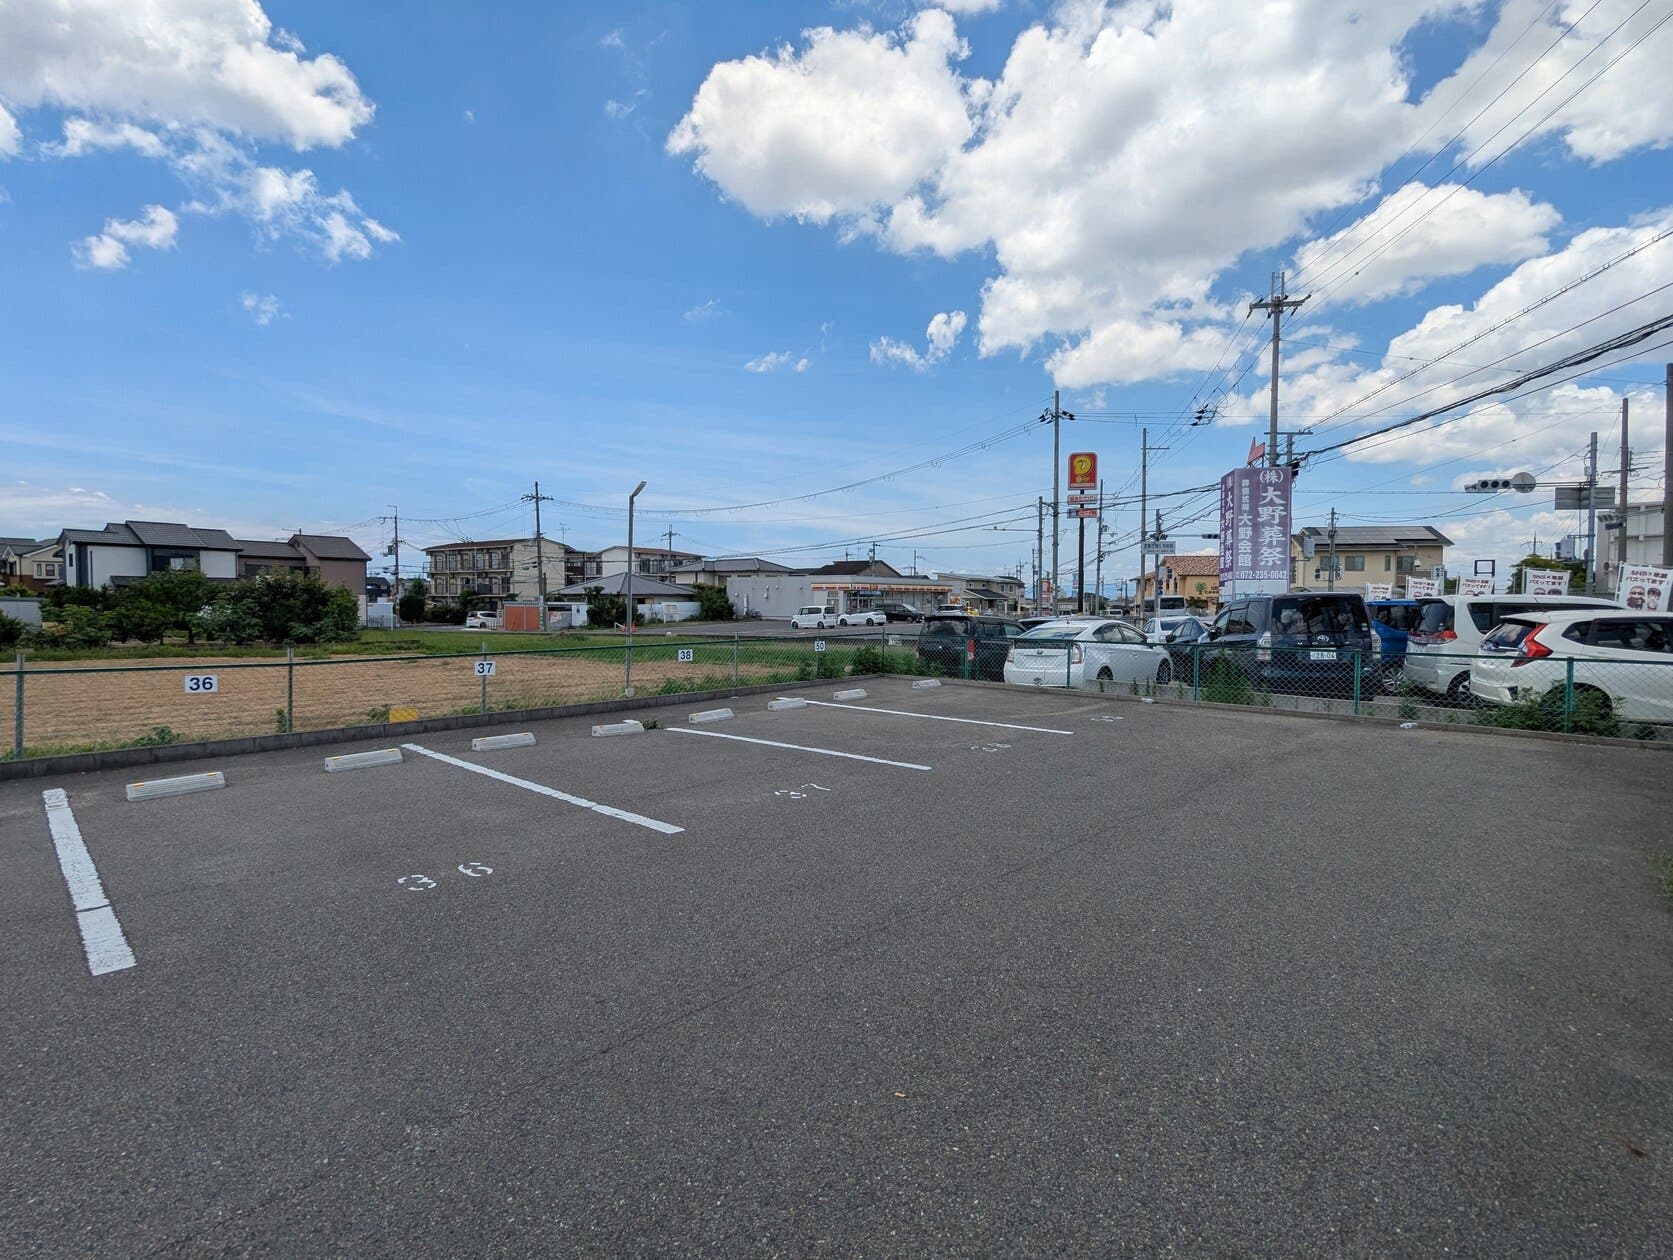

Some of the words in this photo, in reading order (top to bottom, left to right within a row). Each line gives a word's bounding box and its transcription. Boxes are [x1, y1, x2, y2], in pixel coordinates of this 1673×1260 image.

[680, 650, 691, 660] 38
[477, 662, 493, 674] 37
[189, 677, 213, 691] 36
[397, 862, 494, 891] 36
